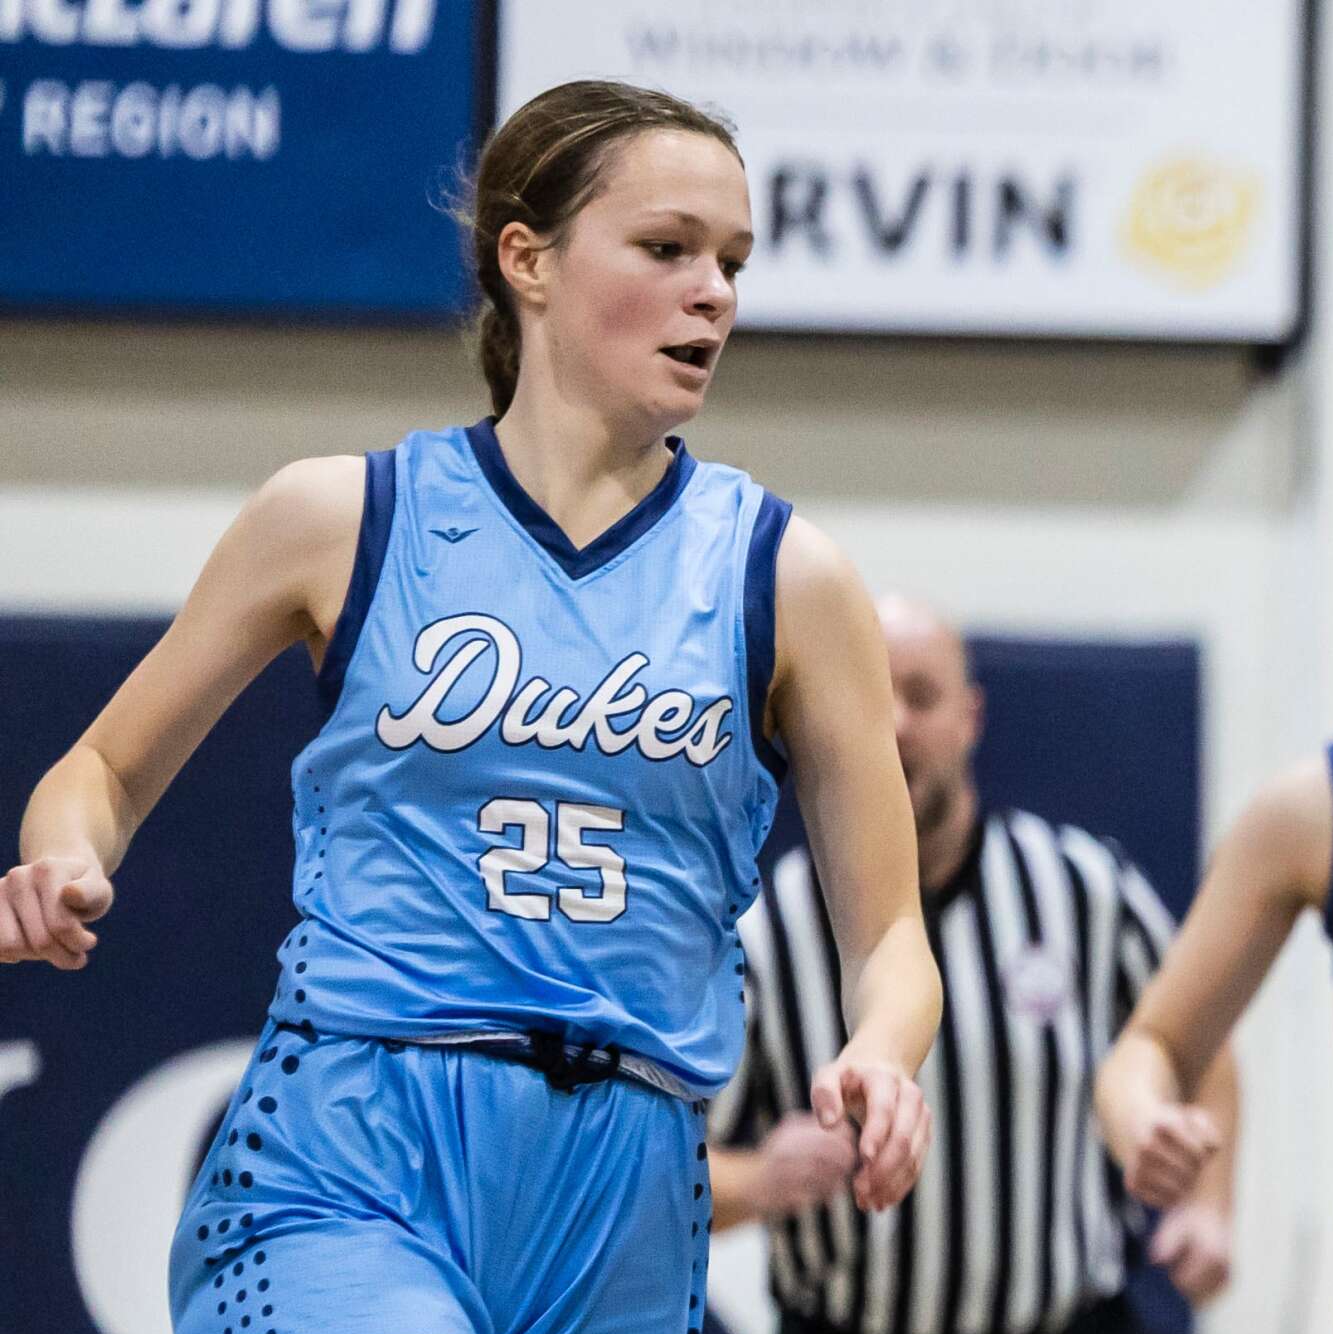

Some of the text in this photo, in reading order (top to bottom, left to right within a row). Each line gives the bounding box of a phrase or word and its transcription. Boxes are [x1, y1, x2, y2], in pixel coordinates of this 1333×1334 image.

[23, 79, 281, 160] REGION
[764, 160, 1081, 260] RVIN
[375, 611, 733, 768] Dukes
[476, 797, 628, 924] 25
